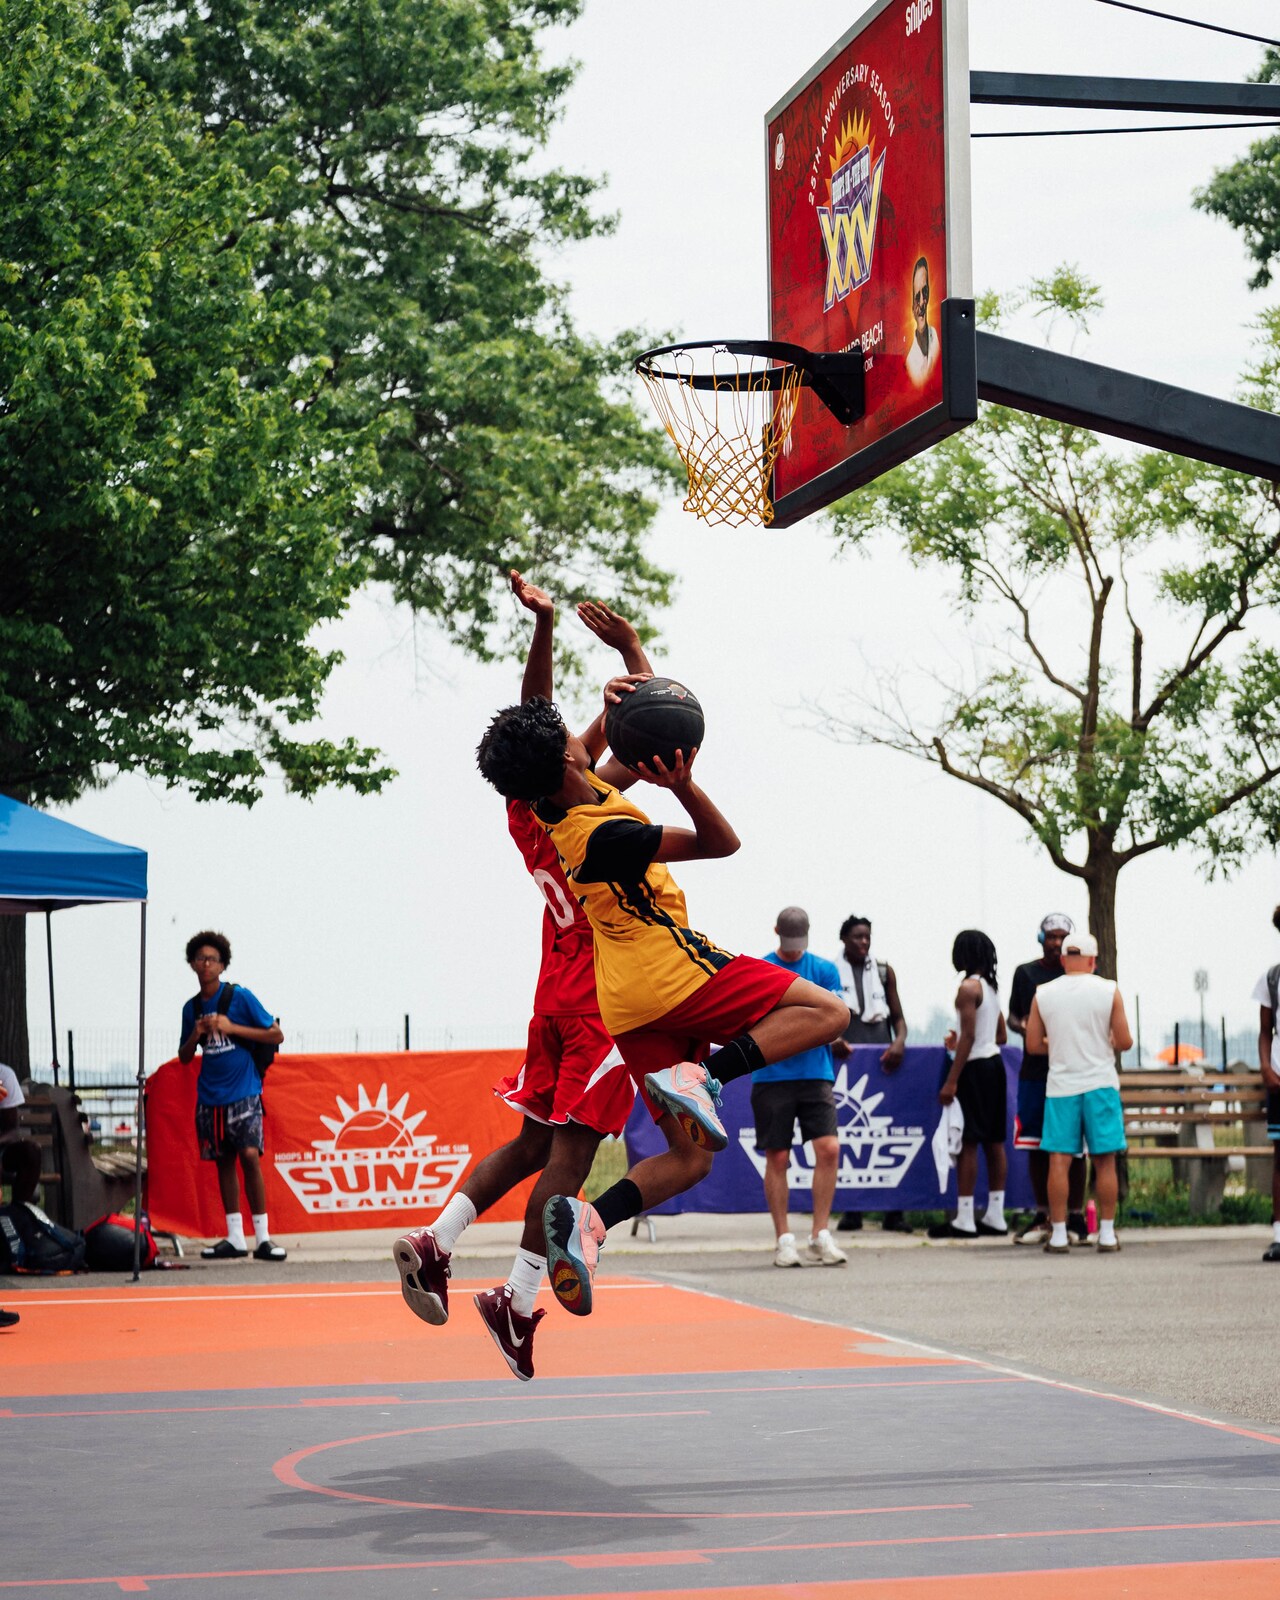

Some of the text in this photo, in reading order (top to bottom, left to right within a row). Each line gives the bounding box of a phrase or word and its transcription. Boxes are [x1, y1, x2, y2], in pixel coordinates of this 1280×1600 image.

[821, 63, 869, 143] ANNIVERSARY
[869, 69, 896, 138] SEASON
[816, 146, 887, 313] XXV
[861, 320, 883, 354] BEACH
[863, 355, 874, 372] ORK
[287, 1160, 460, 1196] SUNS
[312, 1193, 438, 1210] LEAGUE
